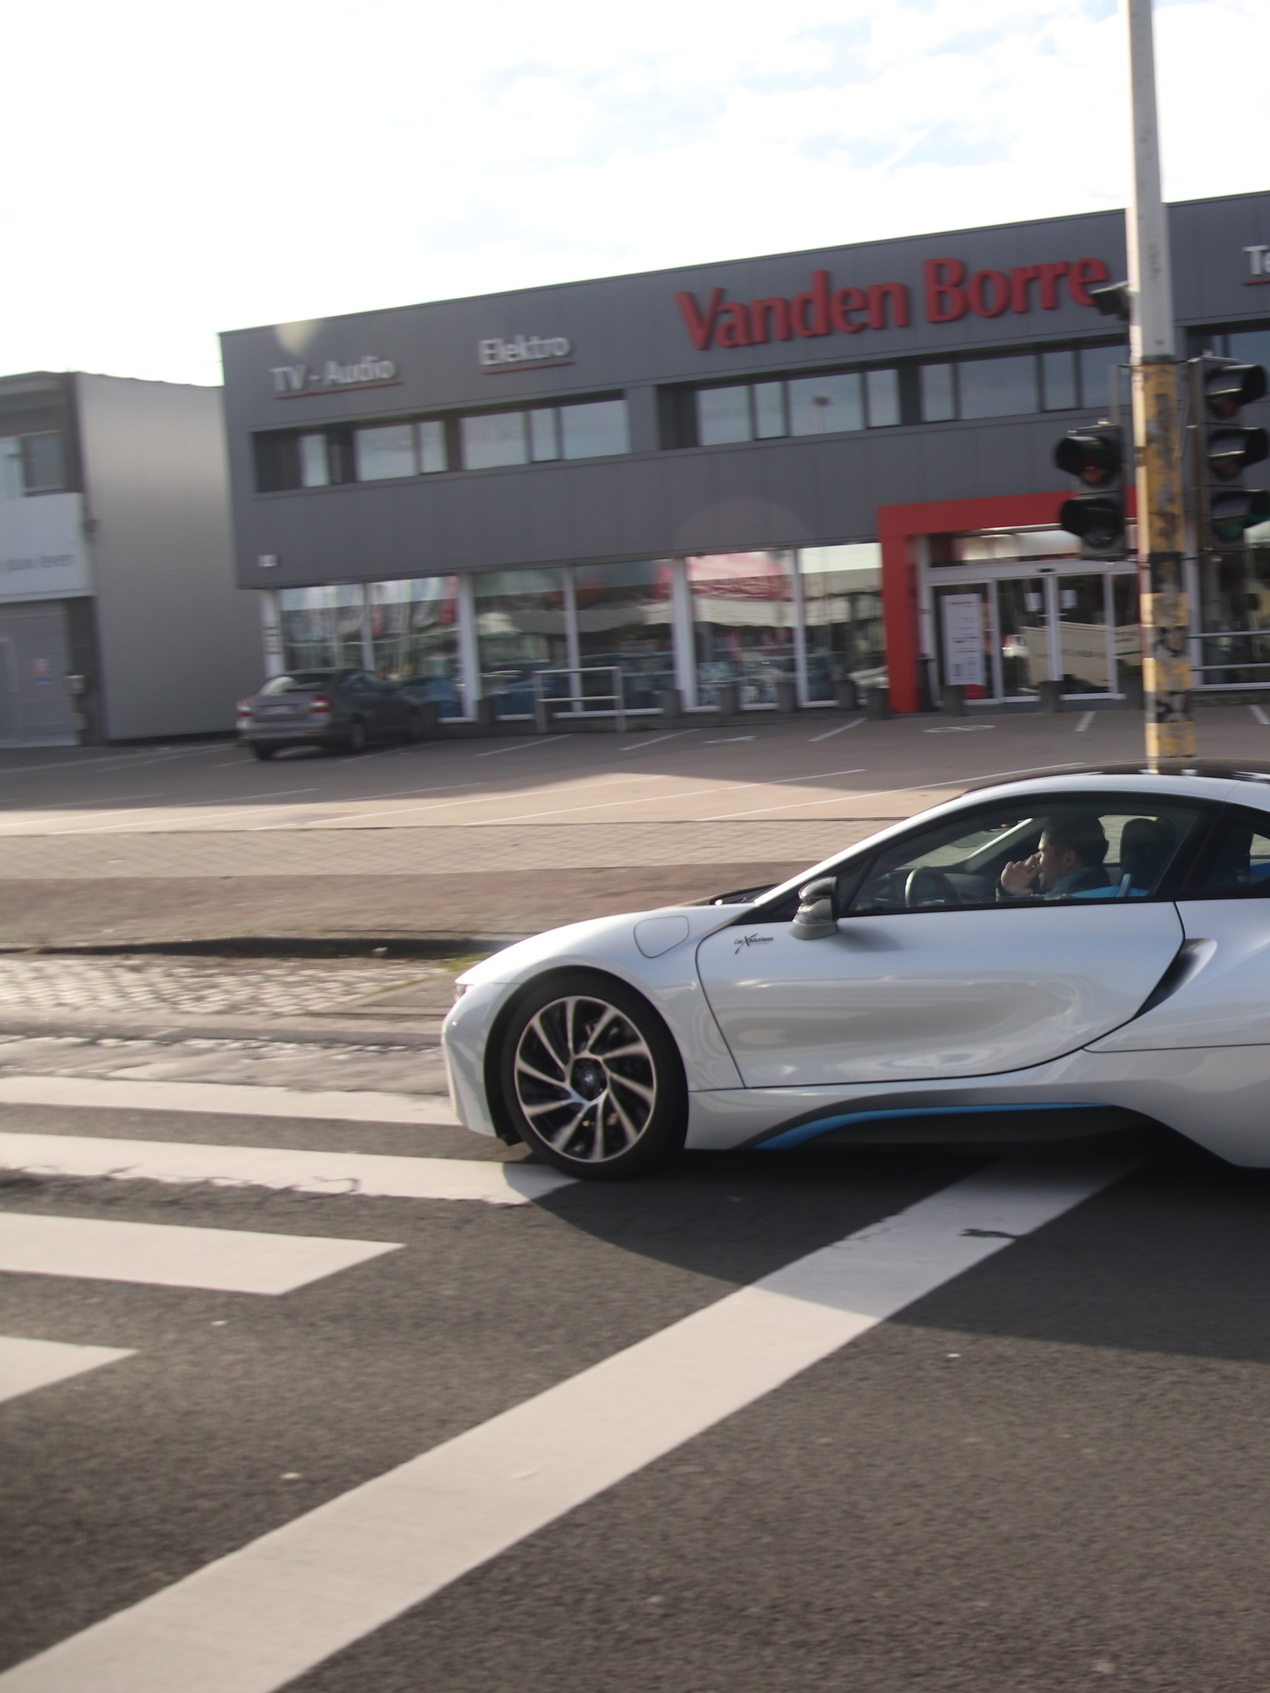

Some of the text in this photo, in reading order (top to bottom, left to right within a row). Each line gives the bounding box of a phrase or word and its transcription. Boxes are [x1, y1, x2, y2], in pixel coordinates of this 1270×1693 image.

[674, 269, 910, 350] Vanden
[922, 257, 1110, 323] Borre
[480, 335, 571, 366] Elektro
